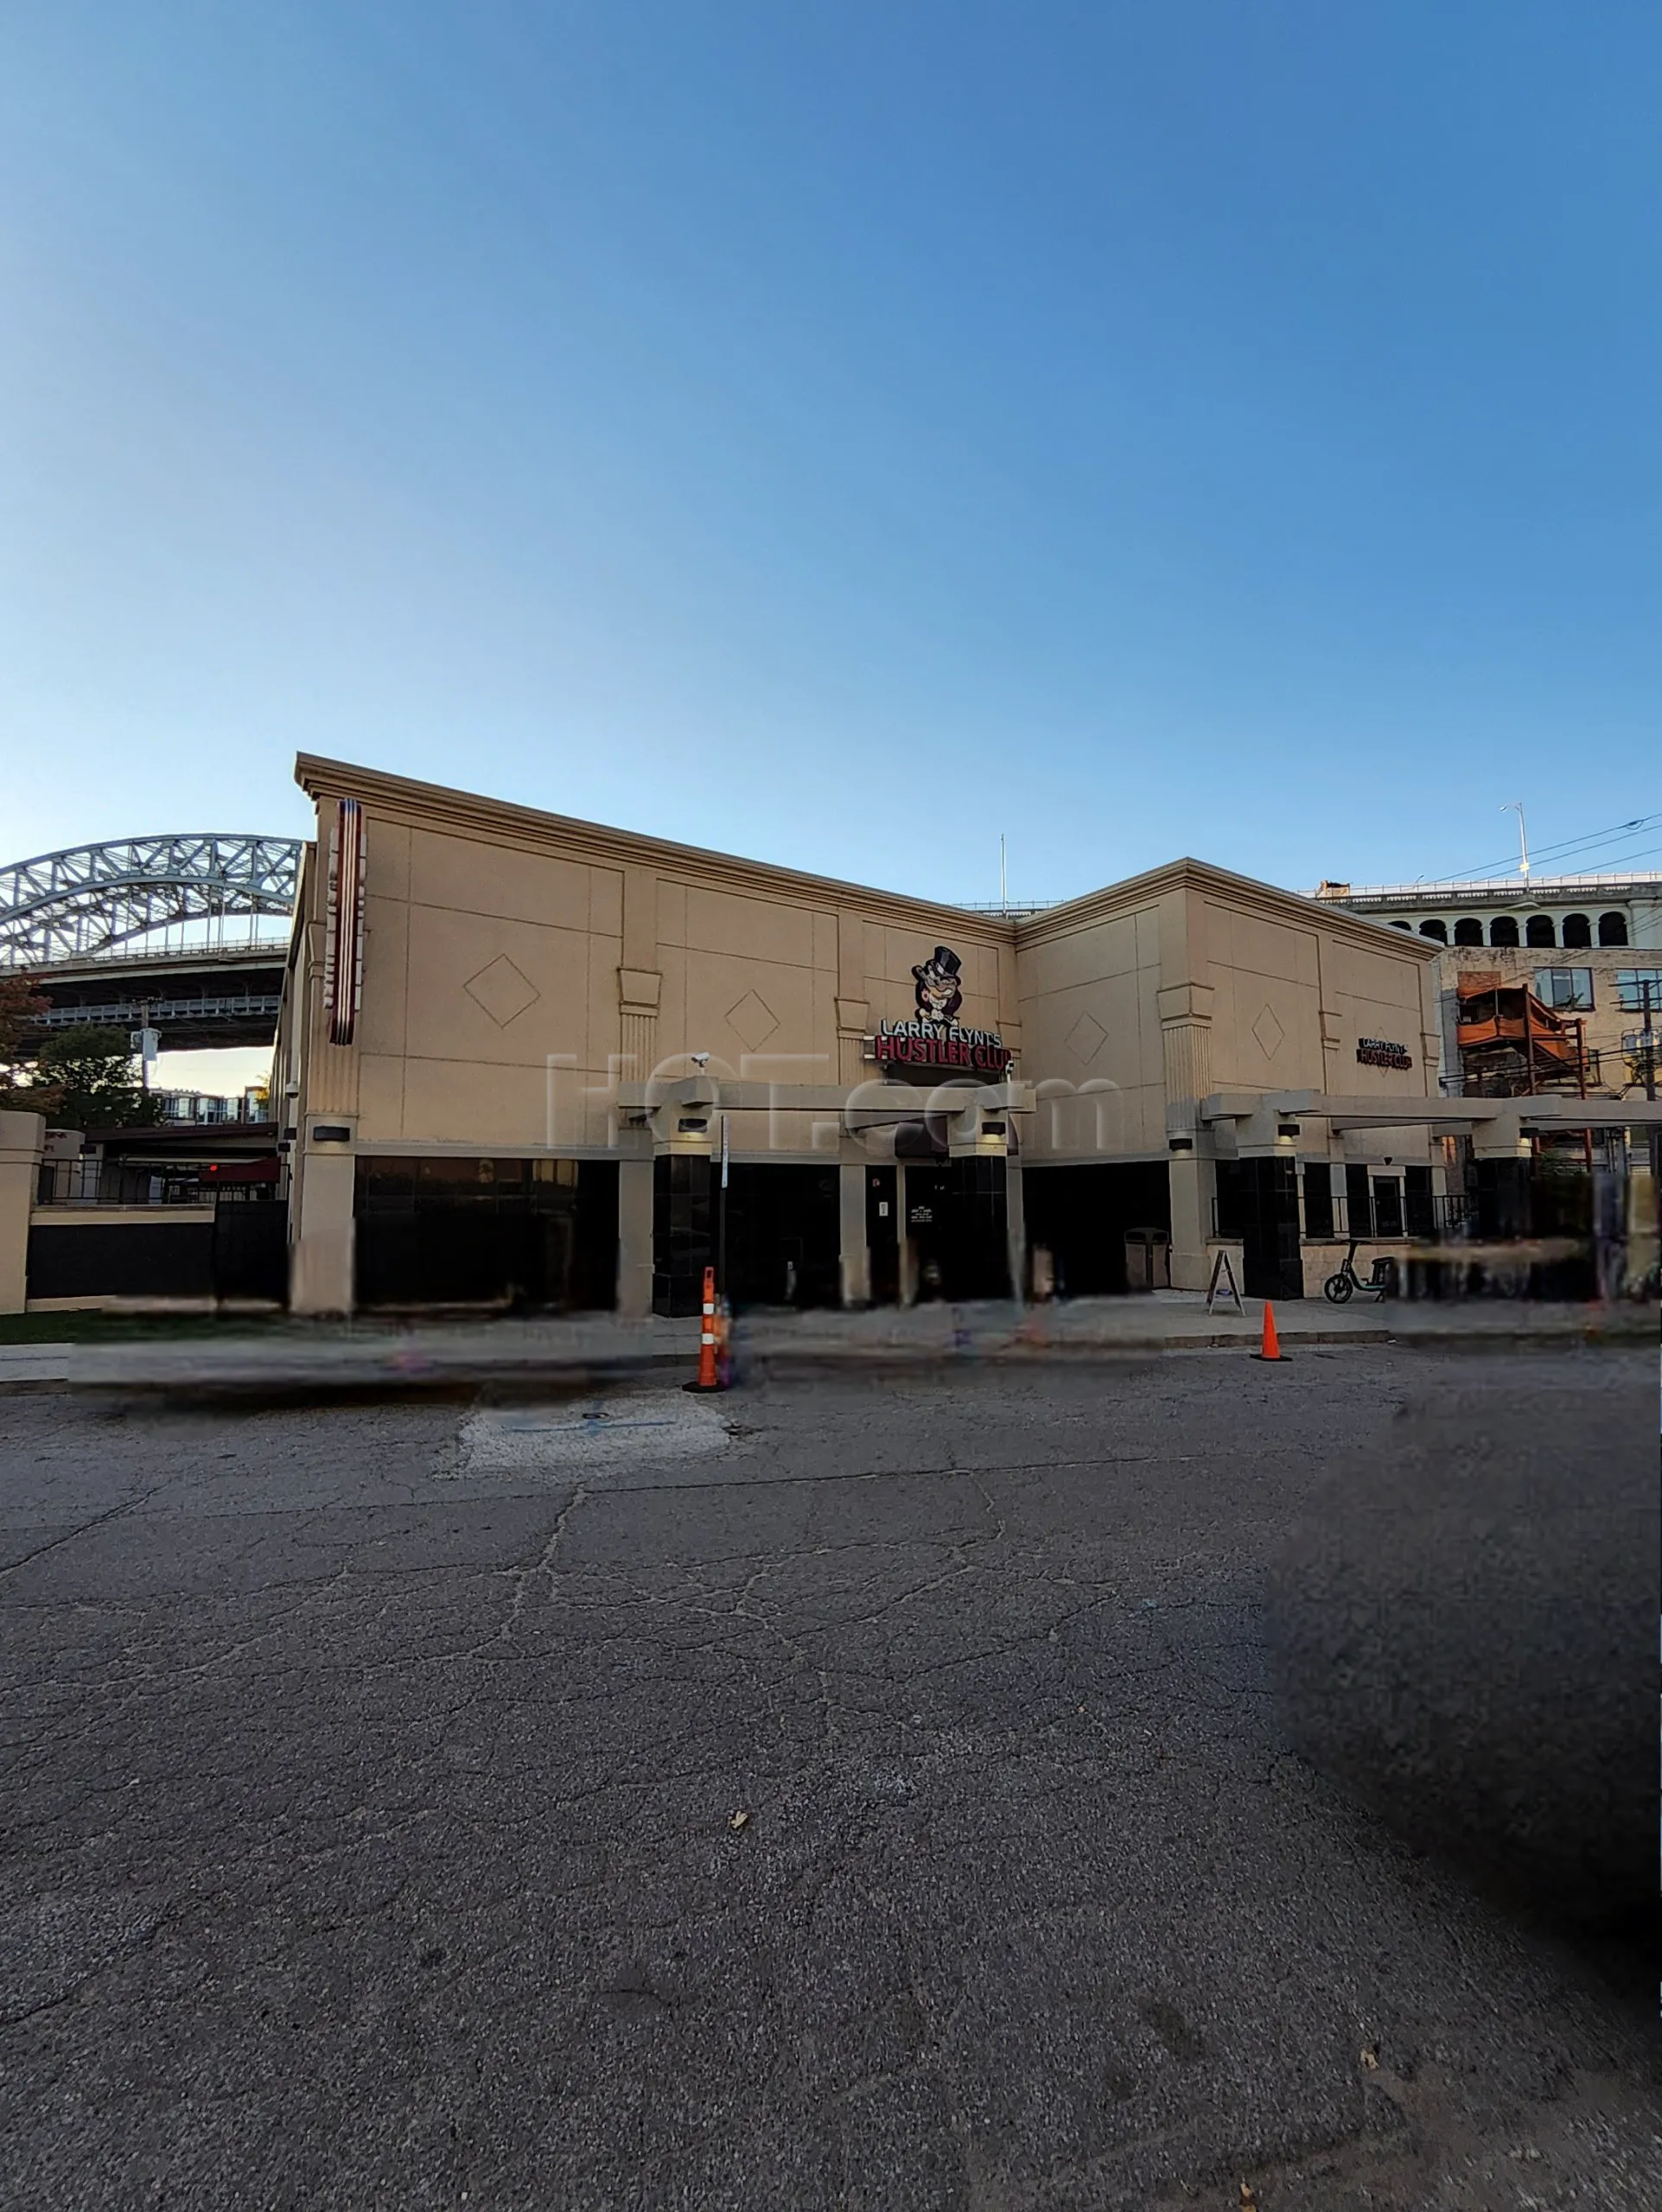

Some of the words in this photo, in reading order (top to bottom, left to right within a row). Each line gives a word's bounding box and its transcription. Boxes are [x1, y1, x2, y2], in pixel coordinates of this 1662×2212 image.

[882, 1019, 945, 1039] LARRY
[876, 1036, 970, 1066] HUSTLER
[1359, 1049, 1393, 1066] HUSTLER
